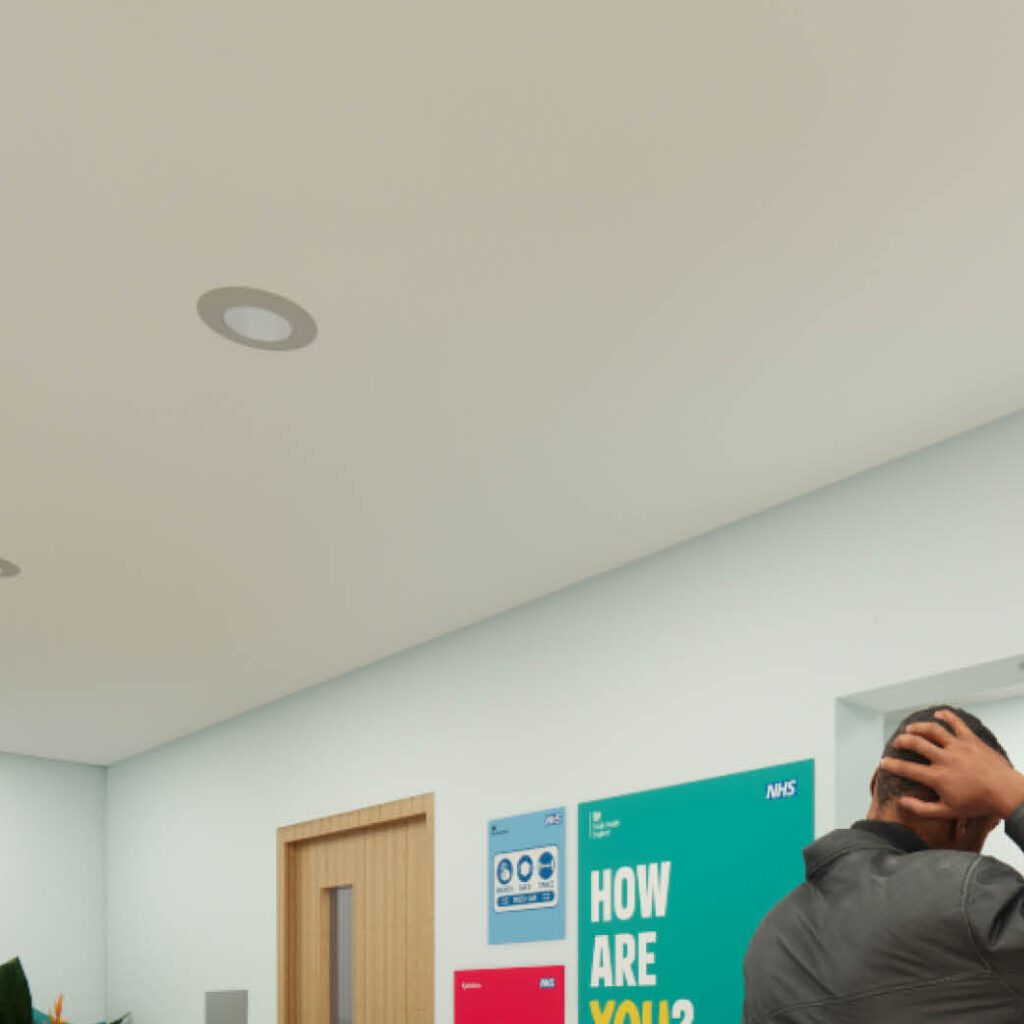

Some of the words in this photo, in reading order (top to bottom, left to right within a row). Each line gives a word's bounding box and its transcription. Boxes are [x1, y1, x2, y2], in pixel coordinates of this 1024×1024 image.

[766, 779, 797, 800] NHS
[590, 861, 671, 922] HOW
[590, 931, 657, 987] ARE
